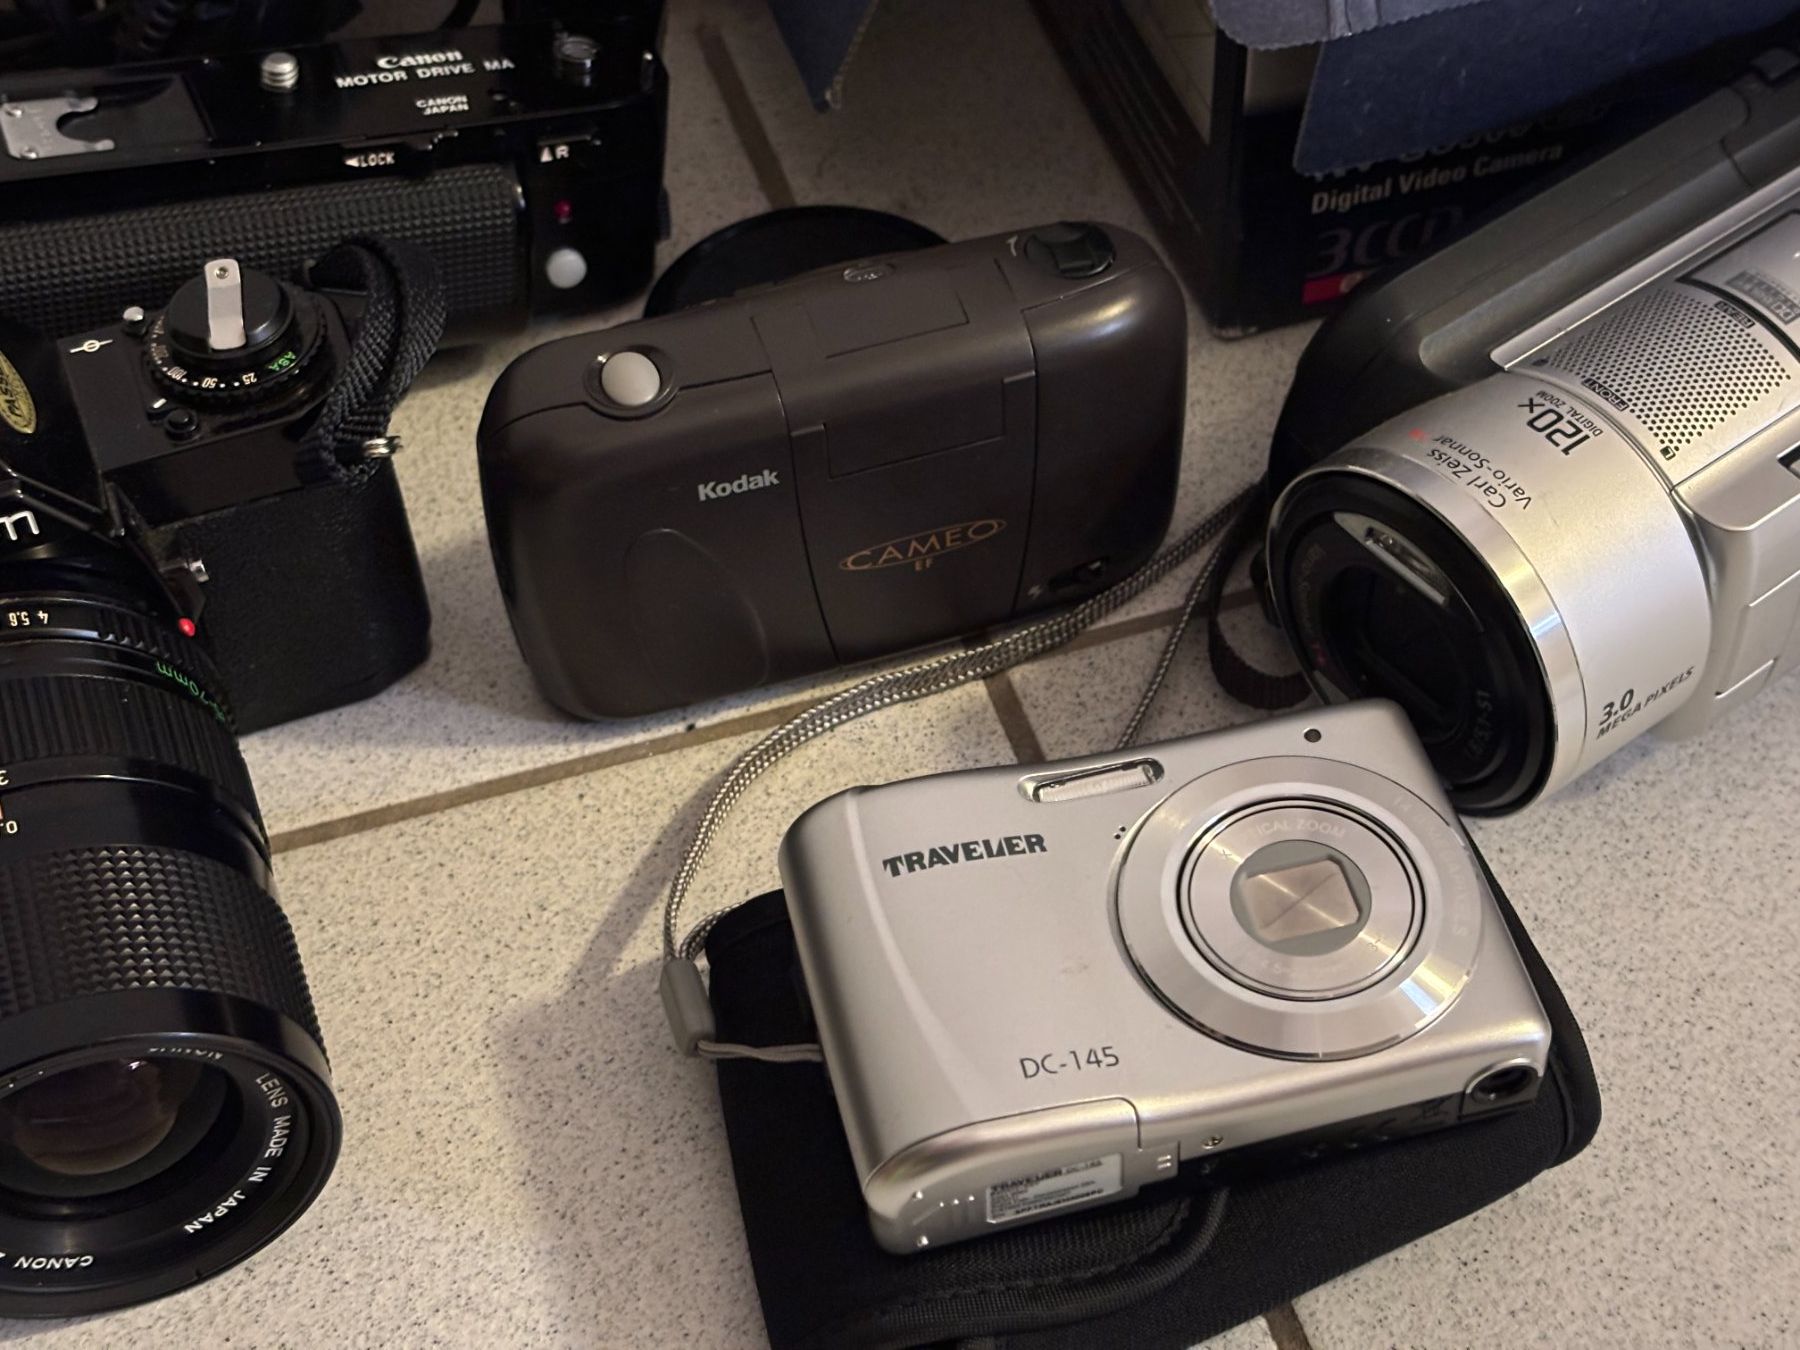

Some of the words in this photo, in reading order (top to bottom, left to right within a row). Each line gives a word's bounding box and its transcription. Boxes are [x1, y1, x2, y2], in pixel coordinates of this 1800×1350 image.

[336, 70, 408, 88] MOTOR
[416, 62, 475, 79] DRIVE
[484, 58, 515, 72] MA
[377, 51, 463, 69] Canon
[416, 95, 468, 108] CANON
[423, 103, 469, 115] JAPAN
[360, 152, 396, 167] LOCK
[1310, 176, 1393, 216] Digital
[1397, 163, 1468, 195] Video
[1472, 143, 1565, 177] Camera
[201, 377, 219, 389] 50
[242, 372, 258, 386] 25
[1582, 378, 1629, 411] FRONT
[1536, 390, 1567, 409] ZOOM
[1566, 406, 1603, 437] DIGITAL
[1426, 447, 1472, 479] Zeiss
[1432, 434, 1532, 510] Vario-Sonnar
[698, 469, 780, 501] Kodak
[1467, 475, 1507, 509] Carl
[846, 519, 999, 571] CAMEO
[7, 611, 31, 627] 5.6
[1595, 703, 1643, 740] MEGA
[1644, 666, 1695, 706] PIXELS
[1598, 688, 1635, 726] 3.0
[882, 833, 1048, 877] TRAVELER
[1019, 1046, 1120, 1079] DC-145
[255, 1072, 289, 1108] LENS
[264, 1114, 297, 1160] MADE
[247, 1165, 273, 1184] IN
[184, 1189, 249, 1235] JAPAN
[11, 1254, 95, 1271] CANON
